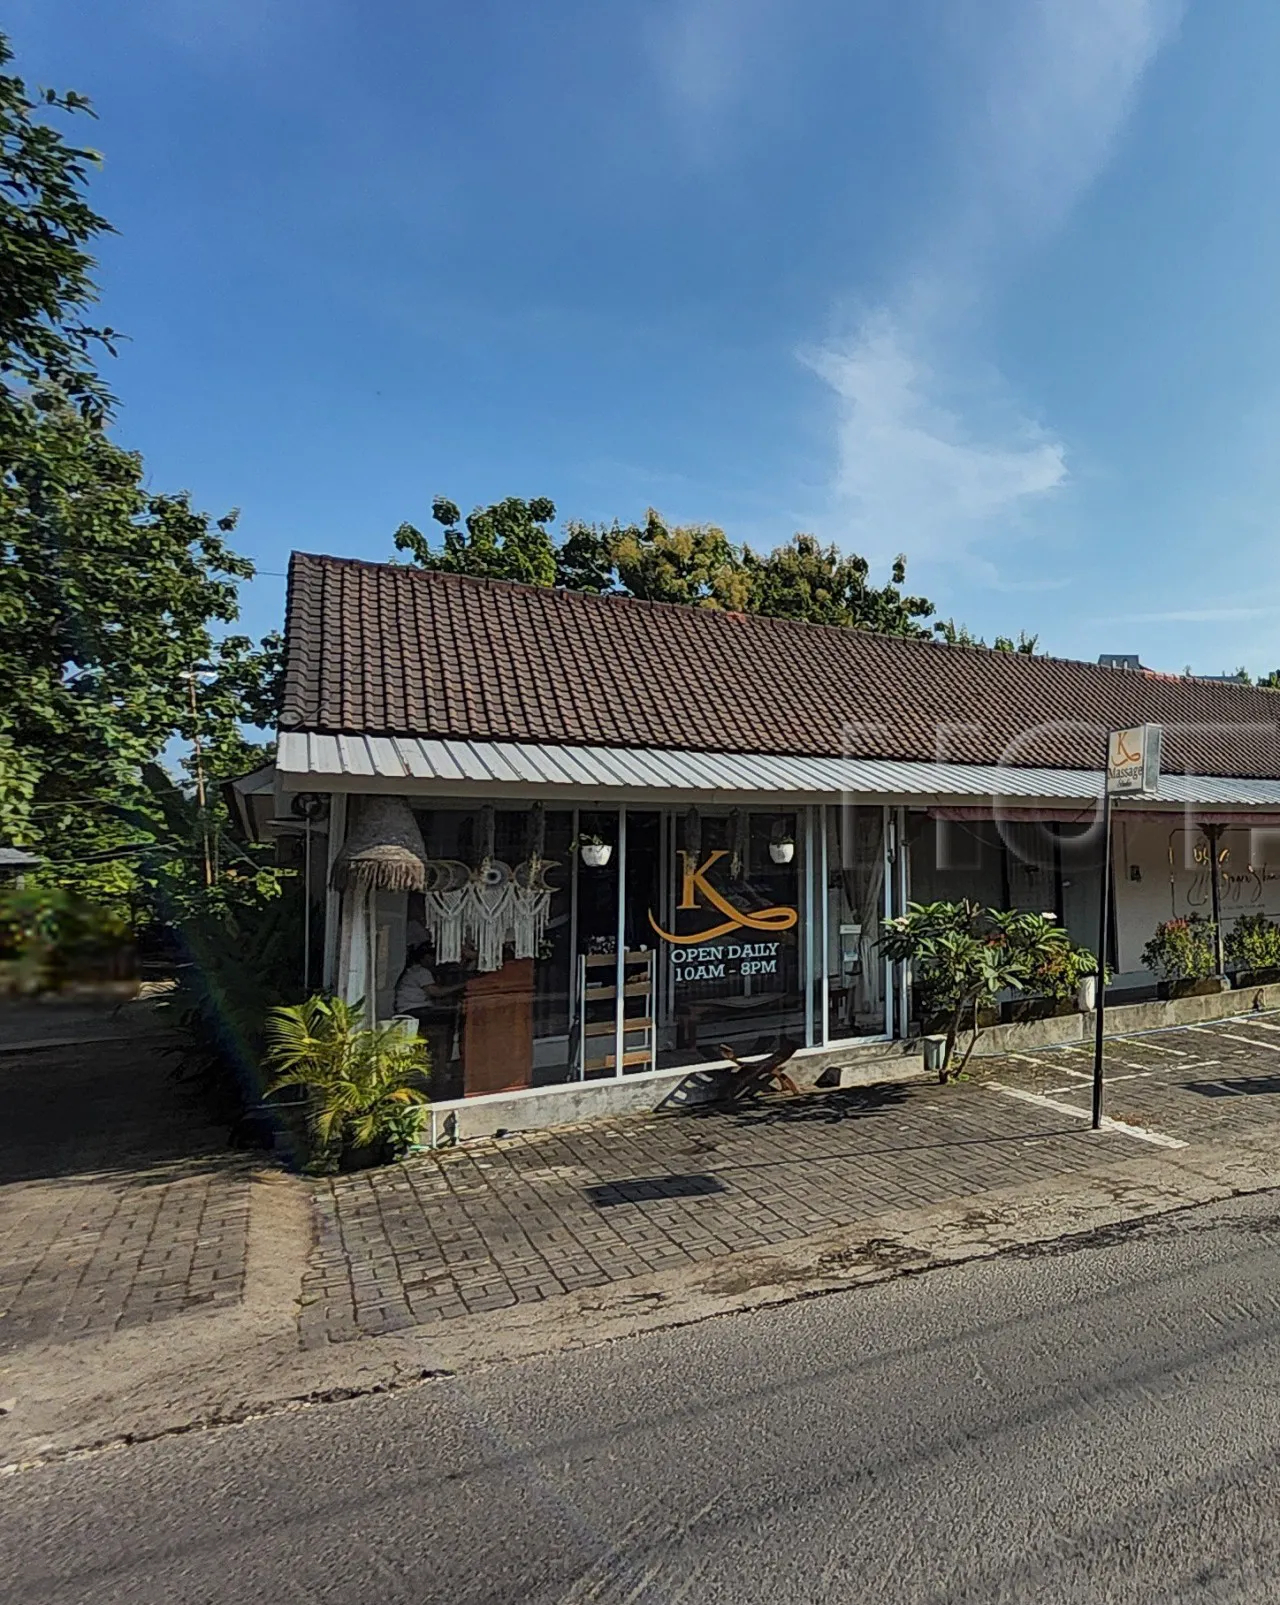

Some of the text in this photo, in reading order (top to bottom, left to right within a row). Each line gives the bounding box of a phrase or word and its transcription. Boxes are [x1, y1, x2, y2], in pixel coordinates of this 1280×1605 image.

[1107, 766, 1144, 780] Massage
[648, 850, 798, 944] K
[671, 942, 780, 964] OPEN DAILY
[675, 963, 726, 982] 10AM
[740, 959, 777, 976] 8PM
